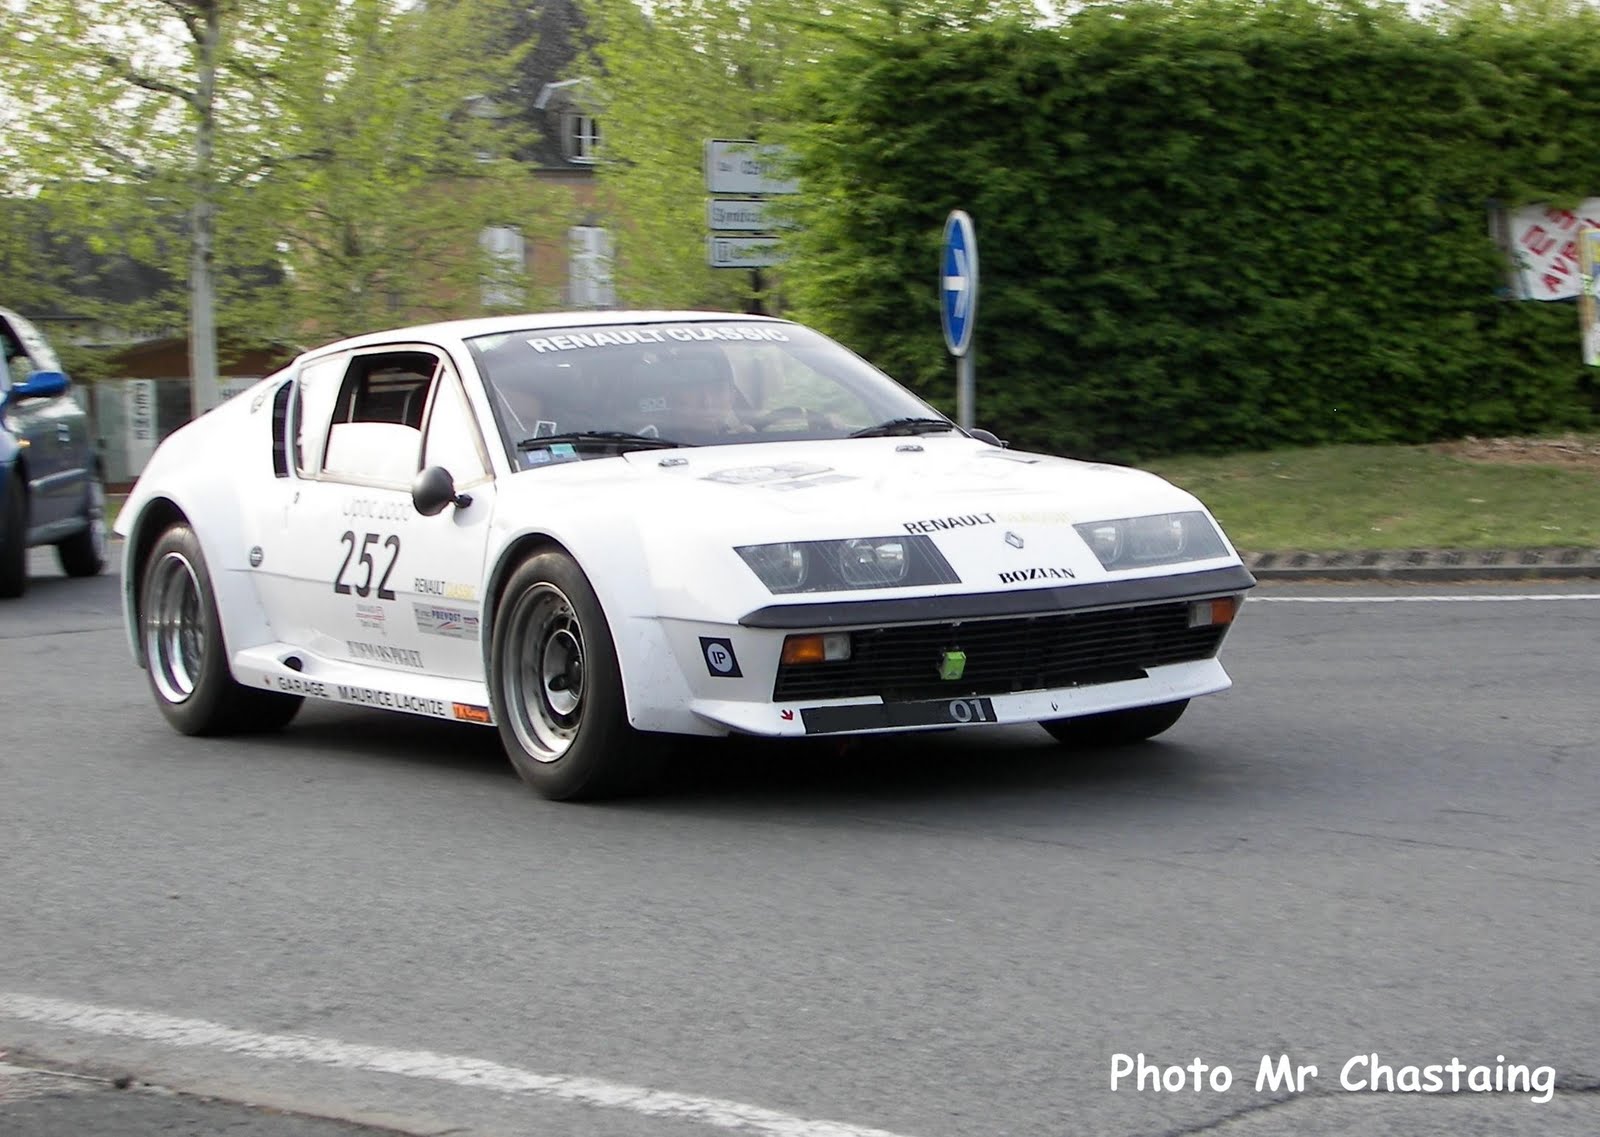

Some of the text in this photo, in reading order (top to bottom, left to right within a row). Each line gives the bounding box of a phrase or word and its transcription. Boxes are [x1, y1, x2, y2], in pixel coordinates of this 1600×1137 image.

[526, 326, 790, 353] RENAULT CLASSIC
[903, 512, 996, 535] RENAULT
[335, 530, 401, 601] 252
[998, 567, 1076, 584] BOZIAN
[414, 577, 446, 595] RENAULT
[712, 651, 726, 665] IP
[279, 676, 328, 697] GARAGE
[338, 685, 392, 707] MAURICE
[393, 693, 446, 716] LACHIZE
[949, 698, 988, 723] 01
